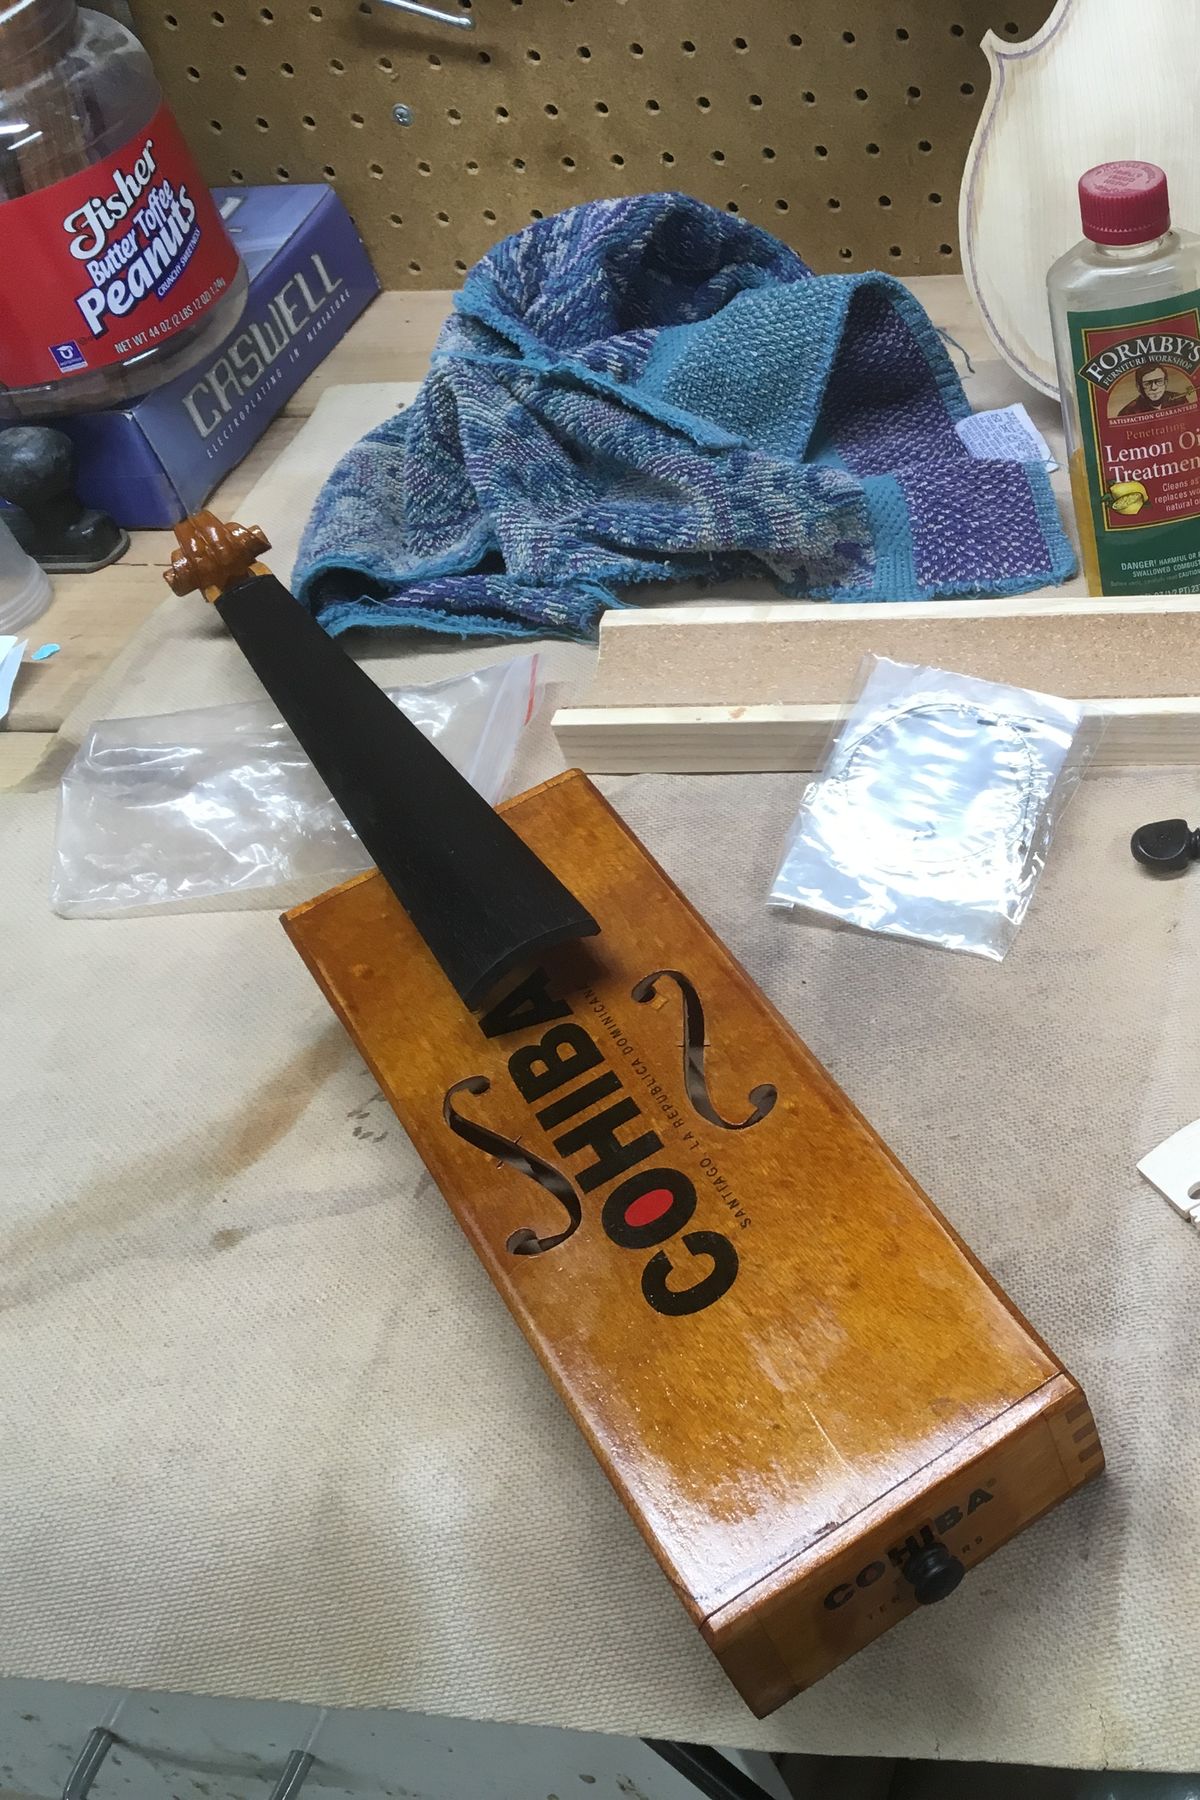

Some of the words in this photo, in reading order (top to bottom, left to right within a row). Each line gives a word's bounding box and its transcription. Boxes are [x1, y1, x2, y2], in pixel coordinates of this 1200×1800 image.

[64, 139, 155, 260] Fisher
[86, 228, 138, 287] Butter
[133, 180, 174, 238] Toffee
[77, 185, 195, 335] Peanuts
[114, 339, 132, 353] NET
[132, 332, 148, 346] WT
[148, 326, 160, 338] 44
[160, 319, 172, 332] OZ
[179, 305, 193, 321] LBS
[182, 254, 343, 438] CASWELL
[206, 368, 282, 458] ELECTROPLATING
[289, 348, 300, 363] IN
[307, 289, 350, 342] MINIATURE
[1103, 357, 1148, 386] FURNITURE
[1148, 355, 1192, 370] WORKSHOP
[1109, 413, 1154, 425] SATISFACTION
[1155, 404, 1198, 418] GUARANTEED
[1126, 422, 1187, 440] Penetrating
[1104, 441, 1174, 463] Lemon
[1154, 491, 1188, 504] replaces
[1162, 480, 1188, 492] Cleans
[1166, 498, 1193, 511] natural
[1121, 560, 1157, 571] DANGER!
[631, 1058, 685, 1128] REPUBLICA
[478, 966, 739, 1317] COHIBA
[683, 1131, 700, 1150] LA
[824, 1488, 994, 1610] COHIBA
